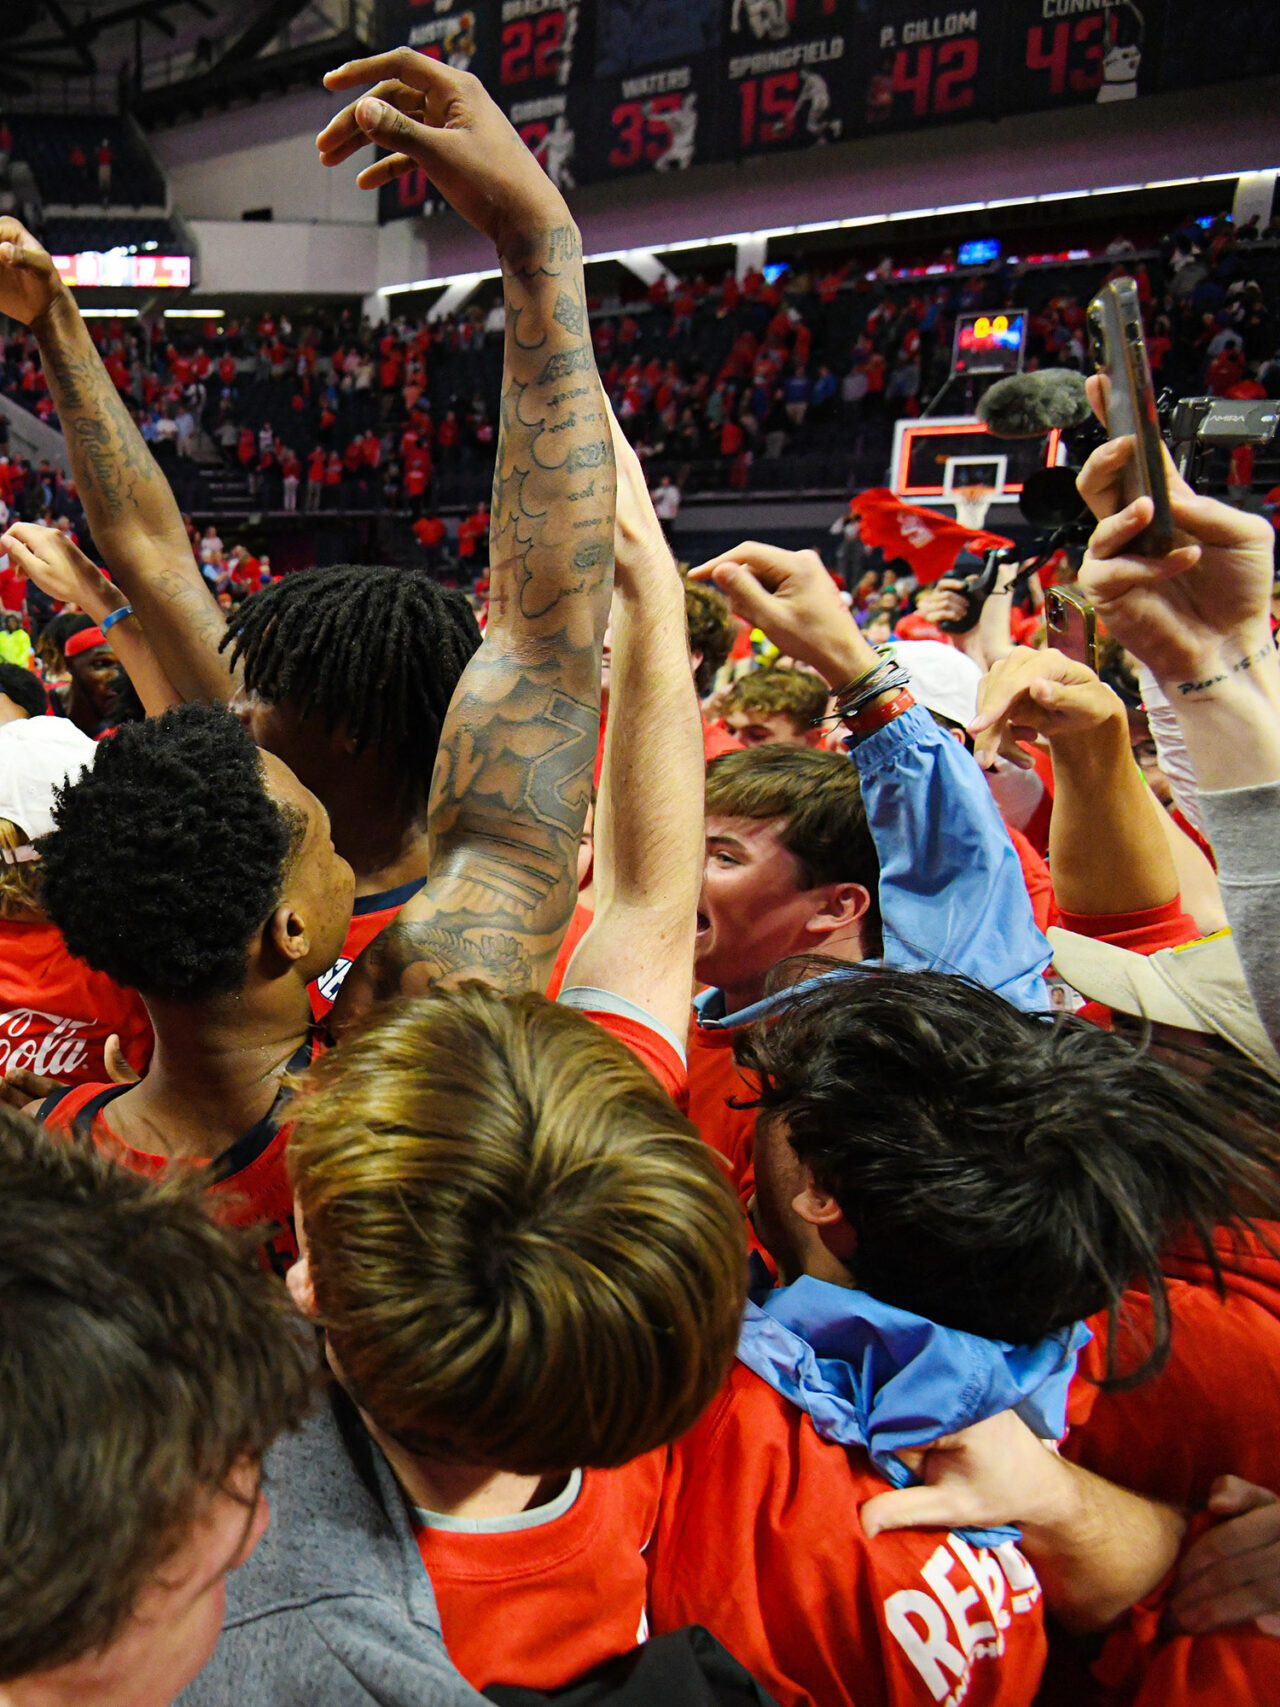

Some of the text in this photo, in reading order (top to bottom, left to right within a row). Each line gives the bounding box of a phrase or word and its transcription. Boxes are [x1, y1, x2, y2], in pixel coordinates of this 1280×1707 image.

[902, 9, 978, 44] GILLOM
[1042, 0, 1123, 18] CONN
[500, 9, 566, 85] 22
[728, 36, 844, 79] SPRINGFIELD
[891, 37, 979, 116] 42
[1026, 14, 1119, 95] 43
[609, 93, 683, 168] 35
[739, 71, 800, 147] 15
[317, 958, 353, 1001] SE
